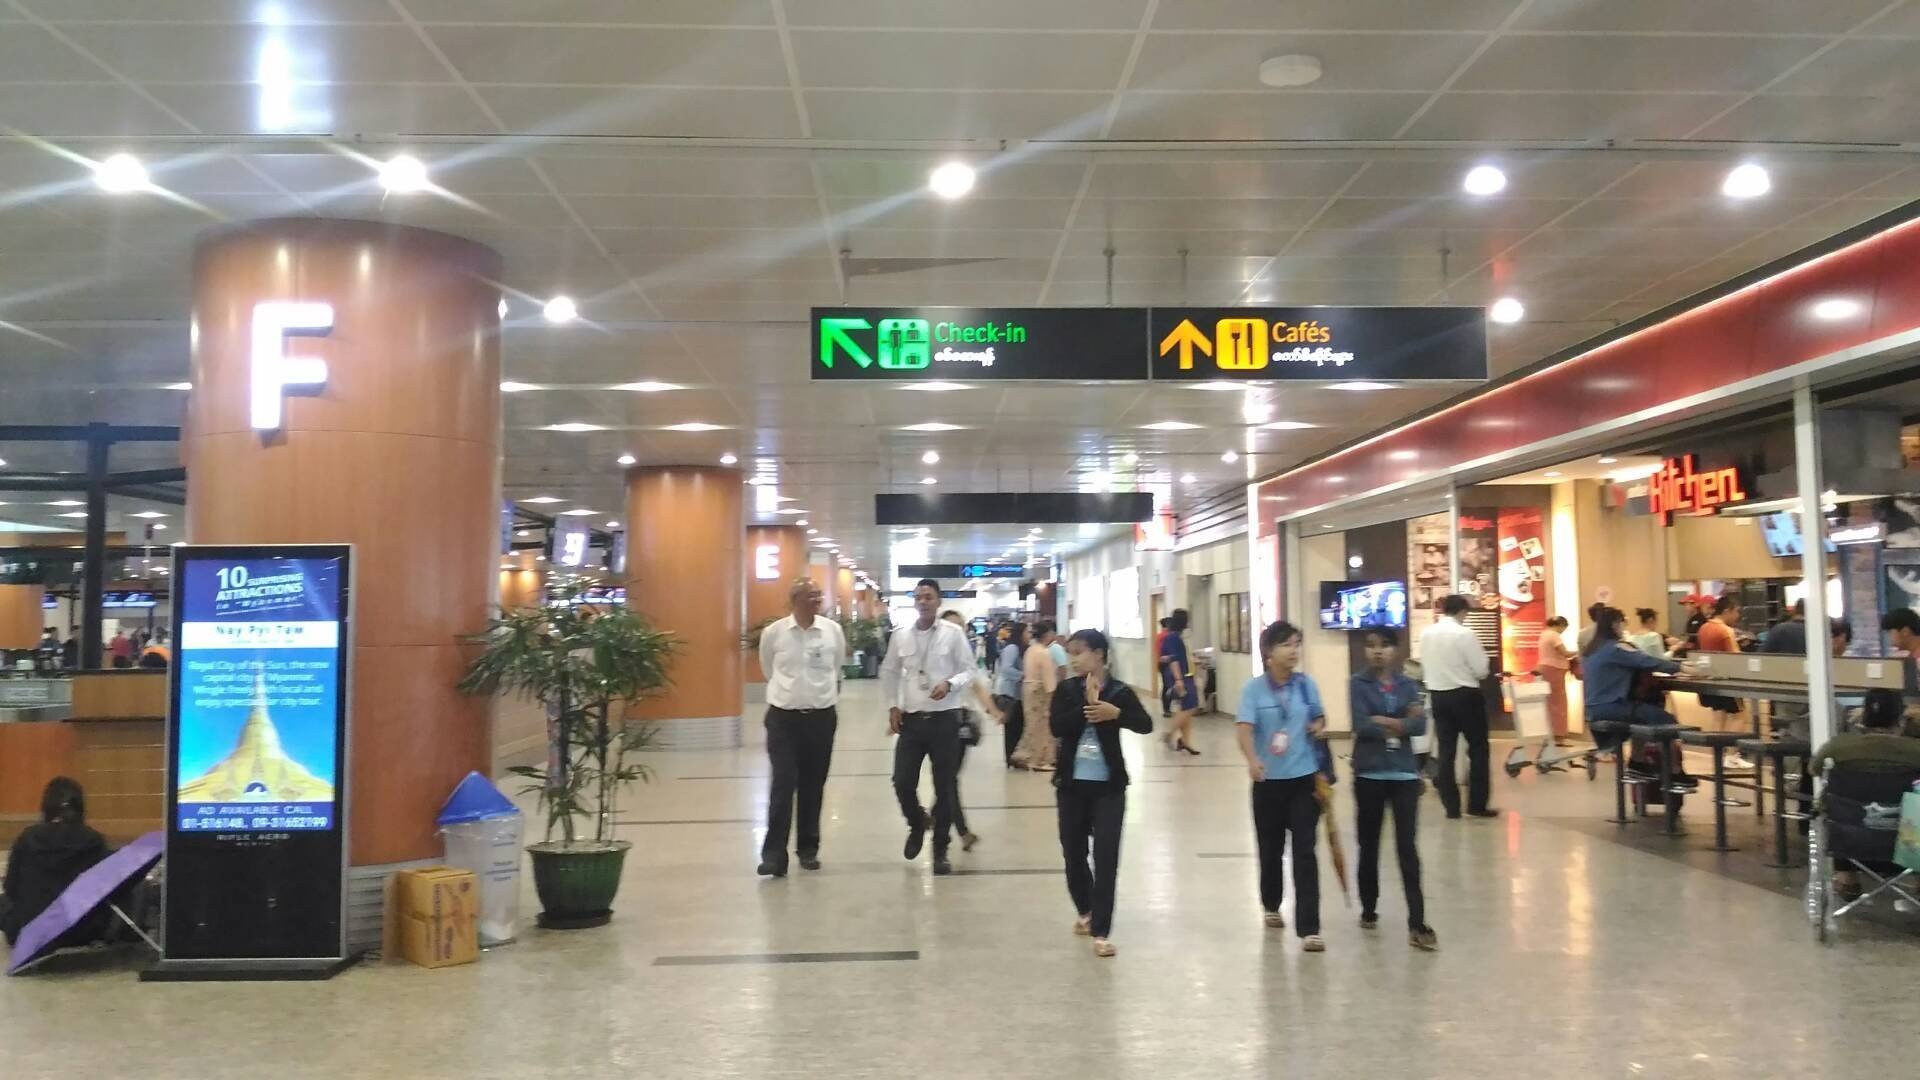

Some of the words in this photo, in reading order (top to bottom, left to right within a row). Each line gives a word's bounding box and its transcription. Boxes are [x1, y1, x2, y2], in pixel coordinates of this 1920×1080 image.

[934, 321, 1026, 343] Check-in
[1272, 321, 1331, 343] Cafés
[250, 302, 334, 430] F
[755, 544, 781, 579] E
[216, 566, 249, 589] 10
[248, 572, 304, 587] SURPRISING
[216, 582, 304, 602] ATTRACTIONS
[197, 806, 216, 815] AD
[219, 805, 281, 815] AVAILABLE
[283, 805, 313, 814] CALL
